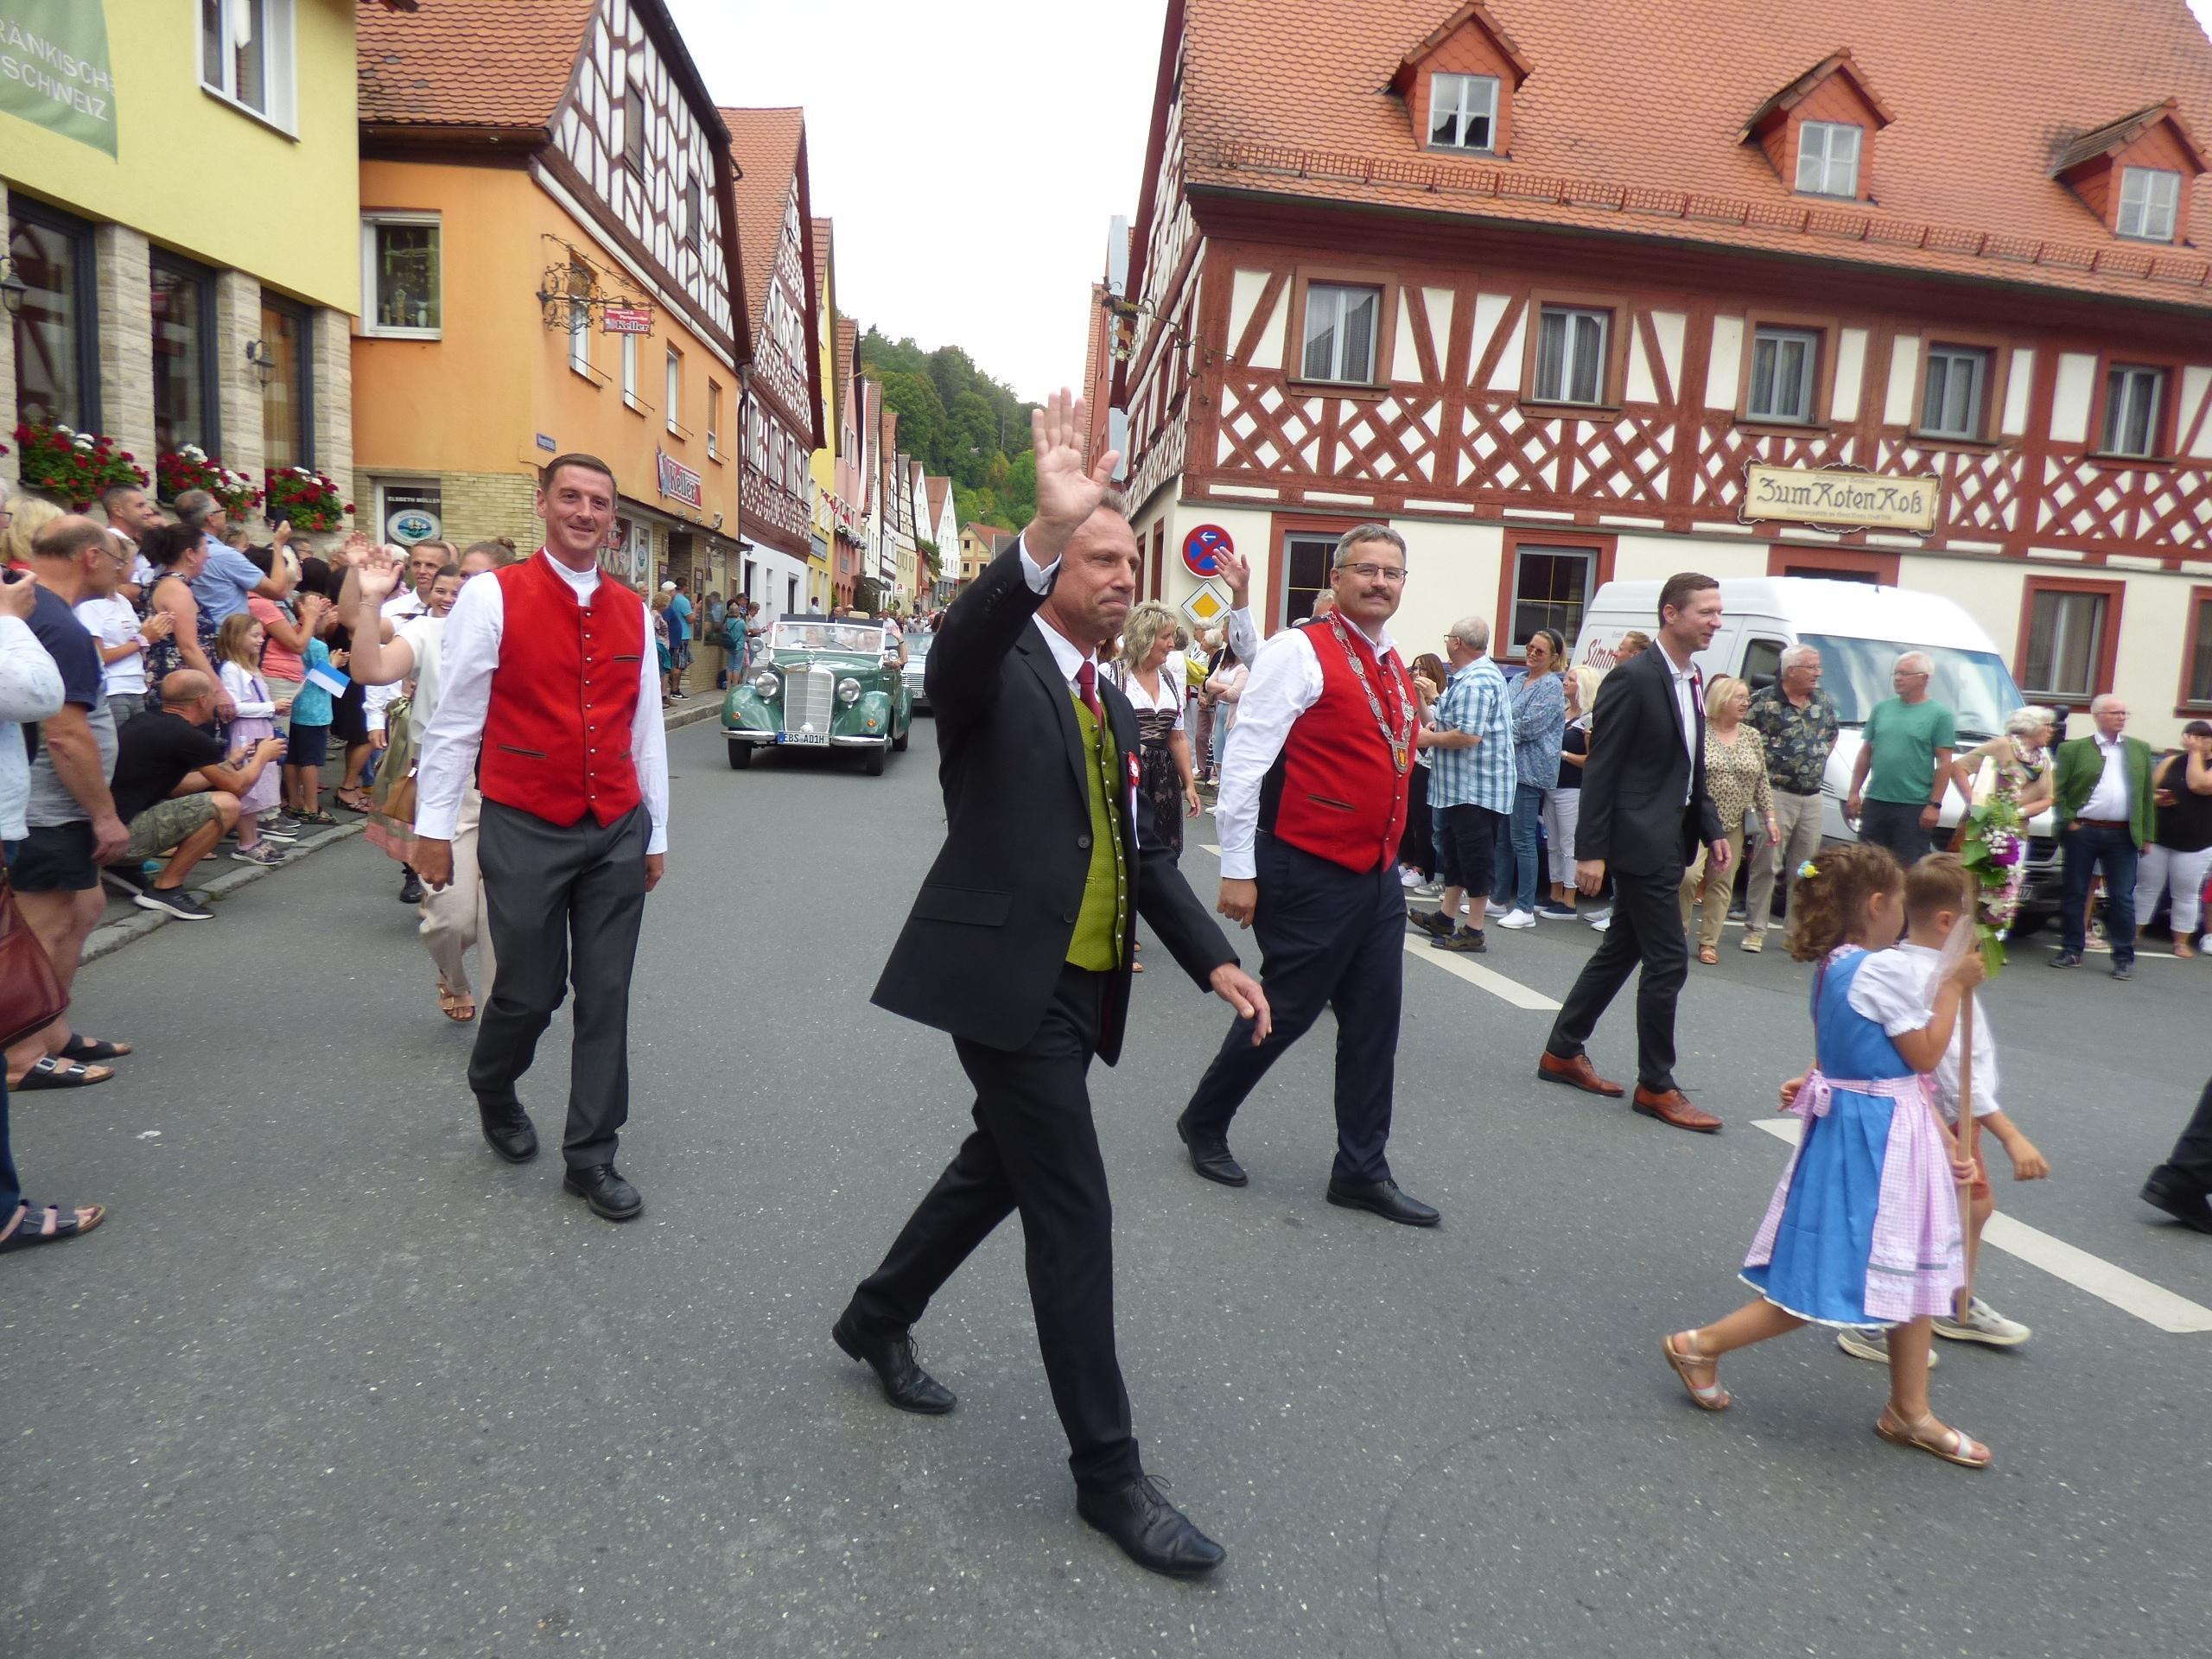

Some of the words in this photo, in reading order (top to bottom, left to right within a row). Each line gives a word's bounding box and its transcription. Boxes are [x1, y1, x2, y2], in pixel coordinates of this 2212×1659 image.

[2, 55, 109, 122] SCHWEIZ
[616, 321, 648, 330] Keller
[669, 464, 695, 500] Keller
[1757, 477, 1811, 505] Zum
[1811, 482, 1877, 511] Roten
[1877, 487, 1923, 514] Roß
[1582, 638, 1617, 671] Simm
[783, 733, 799, 743] EBS
